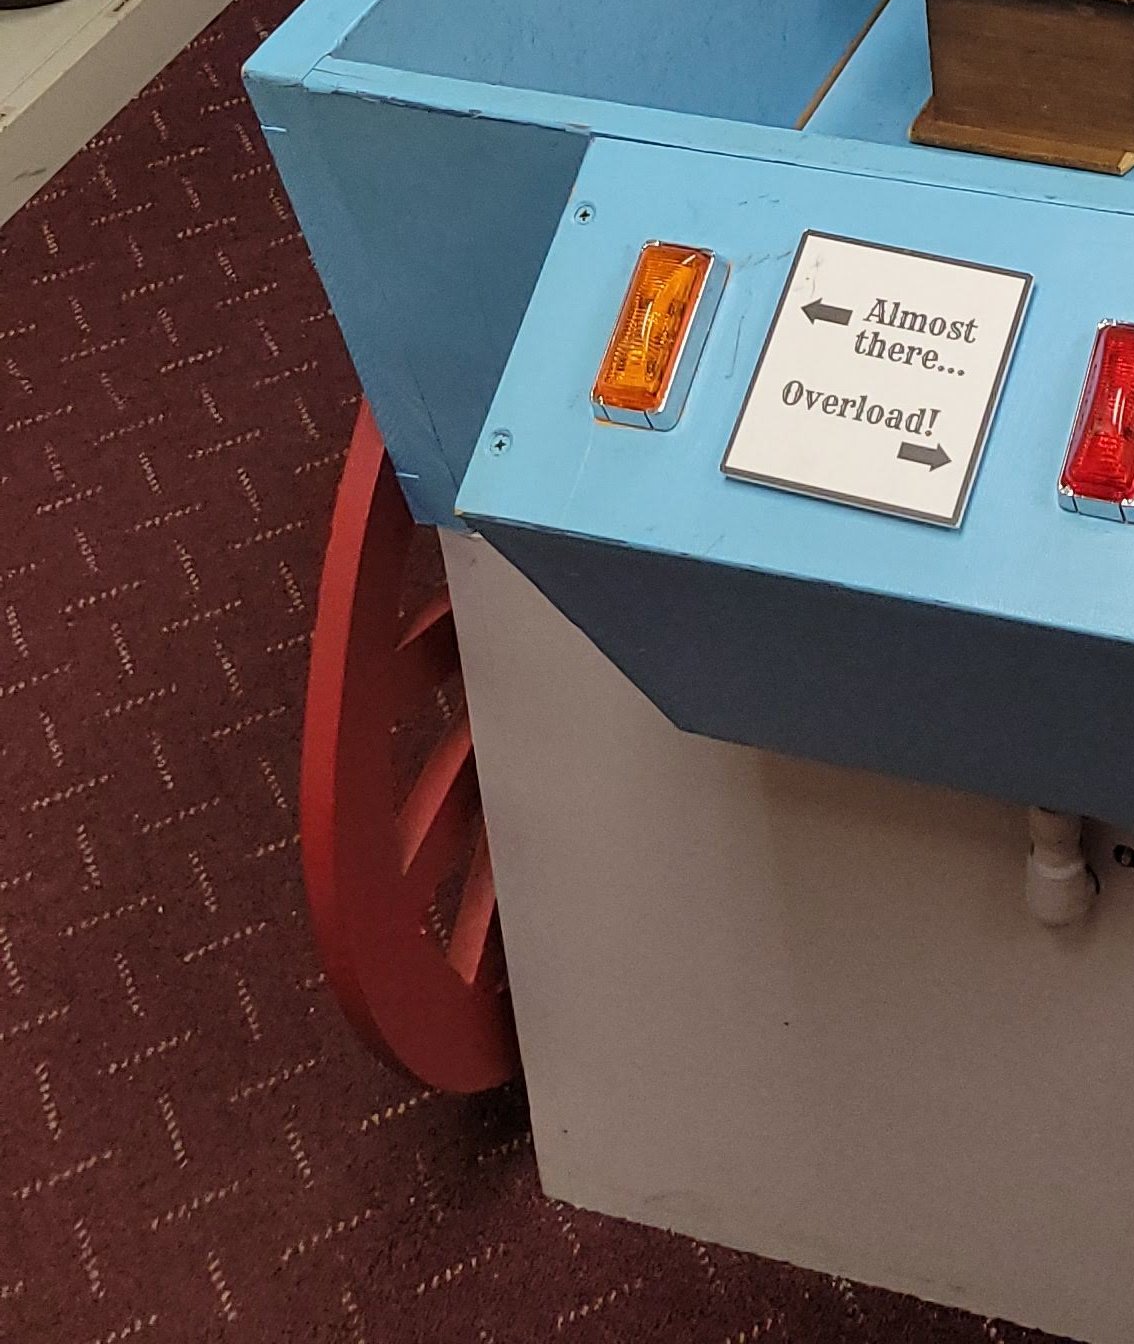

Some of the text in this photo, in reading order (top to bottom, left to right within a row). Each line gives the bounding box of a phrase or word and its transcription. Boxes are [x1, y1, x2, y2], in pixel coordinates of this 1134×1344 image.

[863, 298, 979, 344] Almost
[854, 329, 965, 376] there...
[781, 379, 941, 437] Overload!
